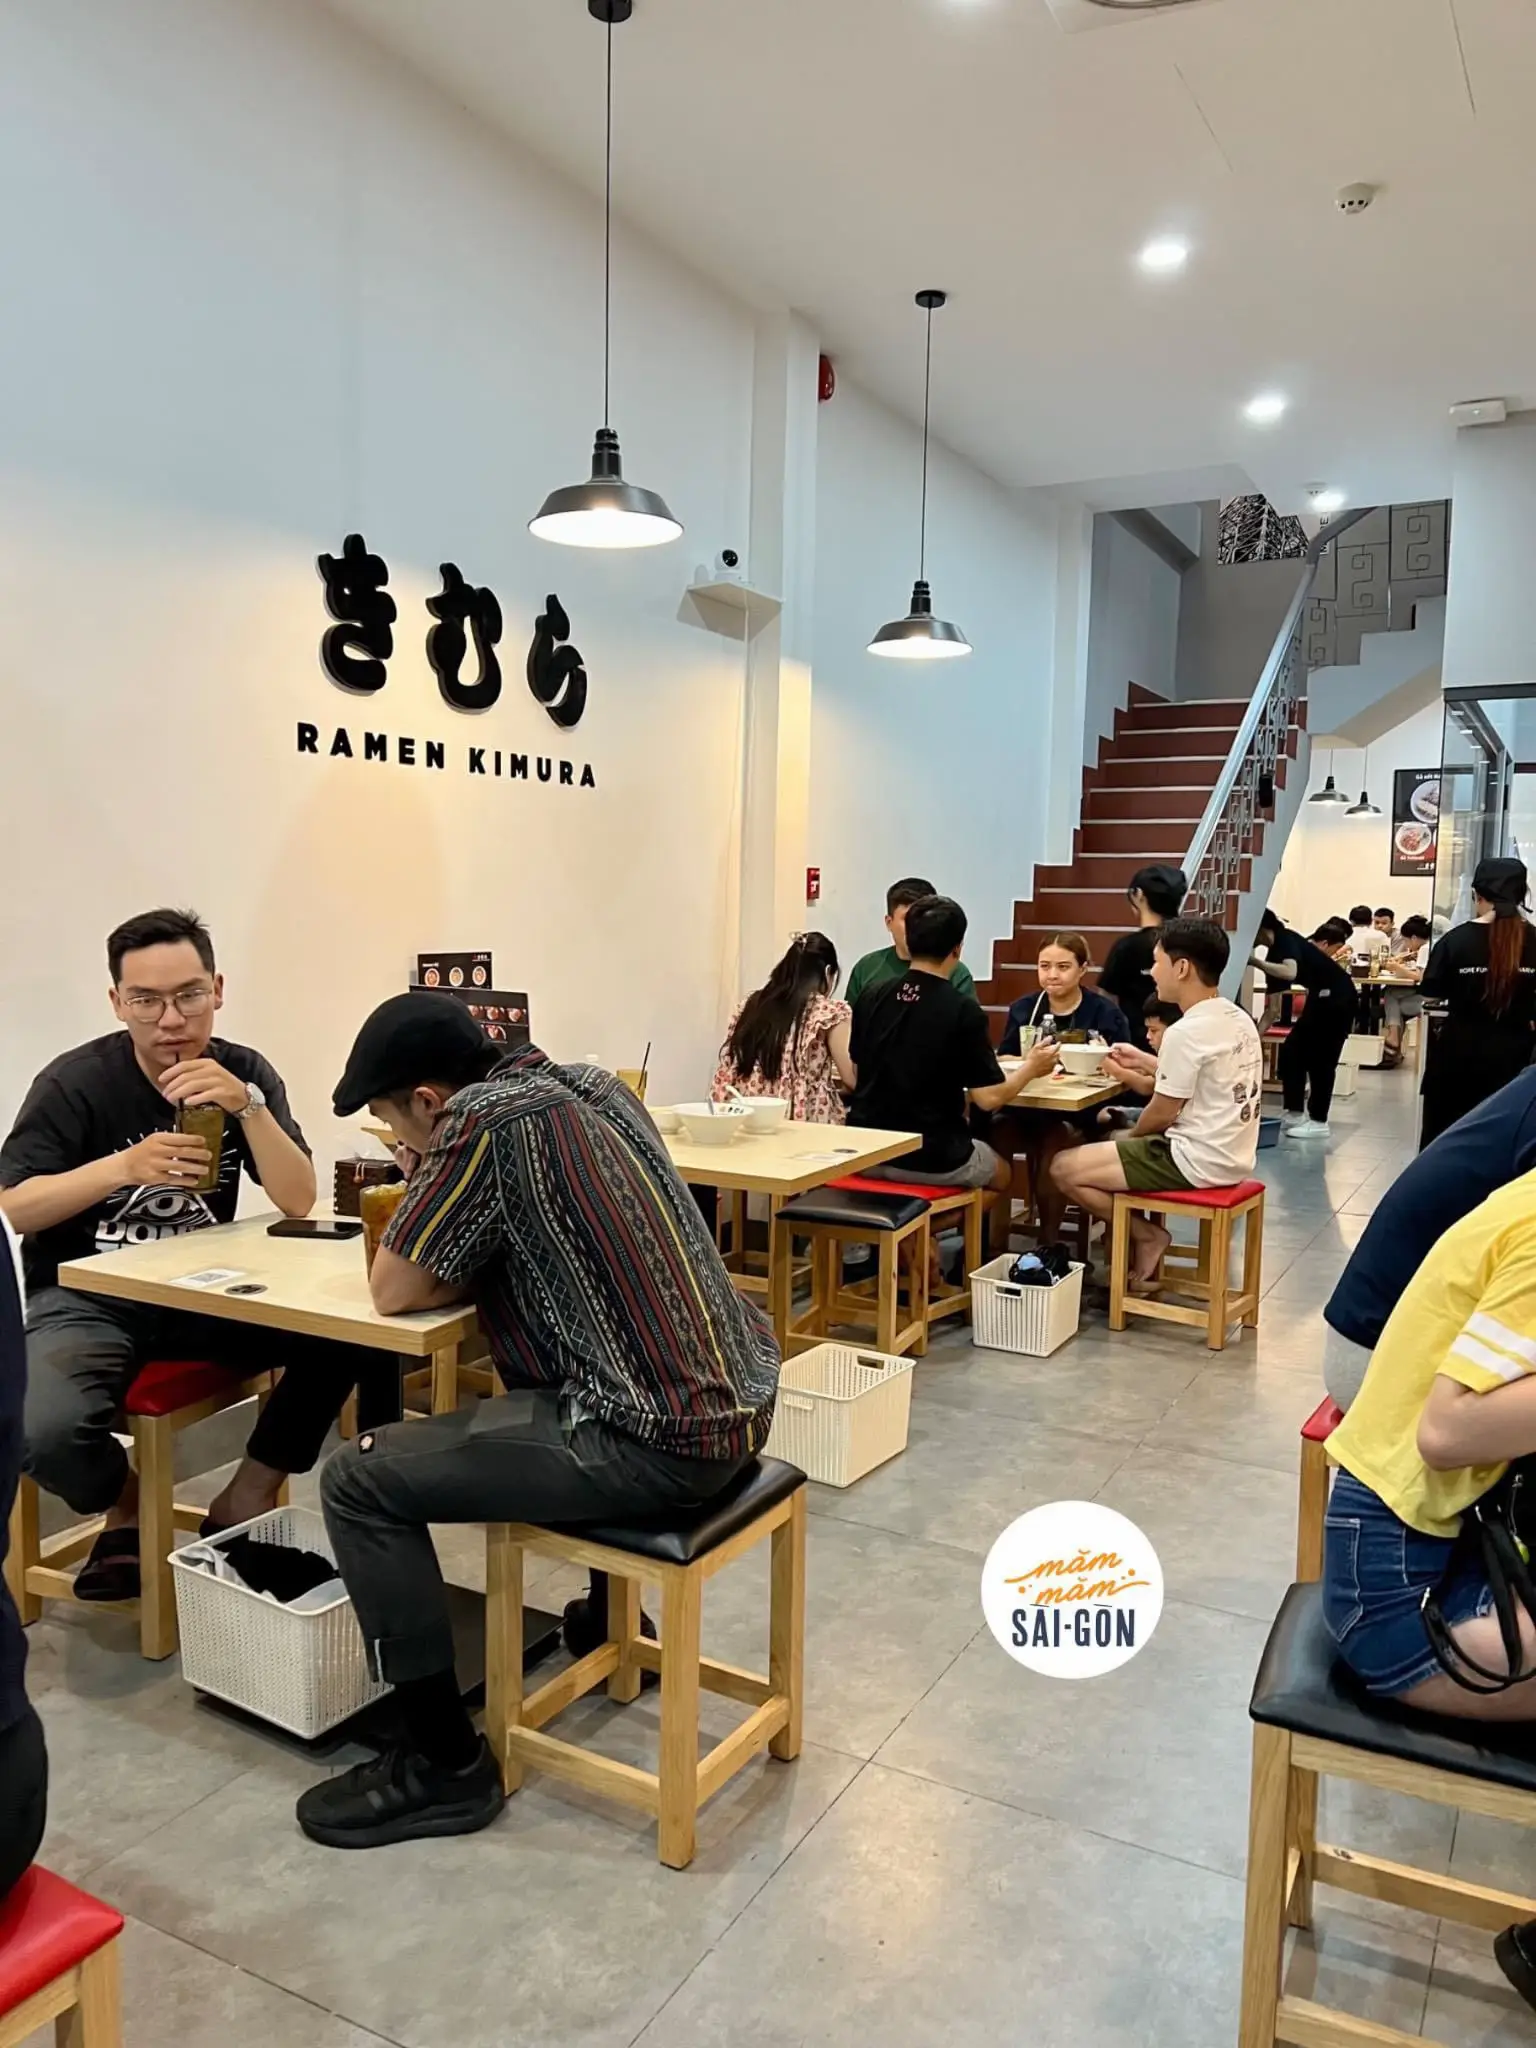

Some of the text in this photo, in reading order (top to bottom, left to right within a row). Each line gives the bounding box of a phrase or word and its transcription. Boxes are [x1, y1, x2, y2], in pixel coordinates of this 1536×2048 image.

[316, 533, 588, 731] きむら
[297, 721, 597, 788] RAMEN KIMURA
